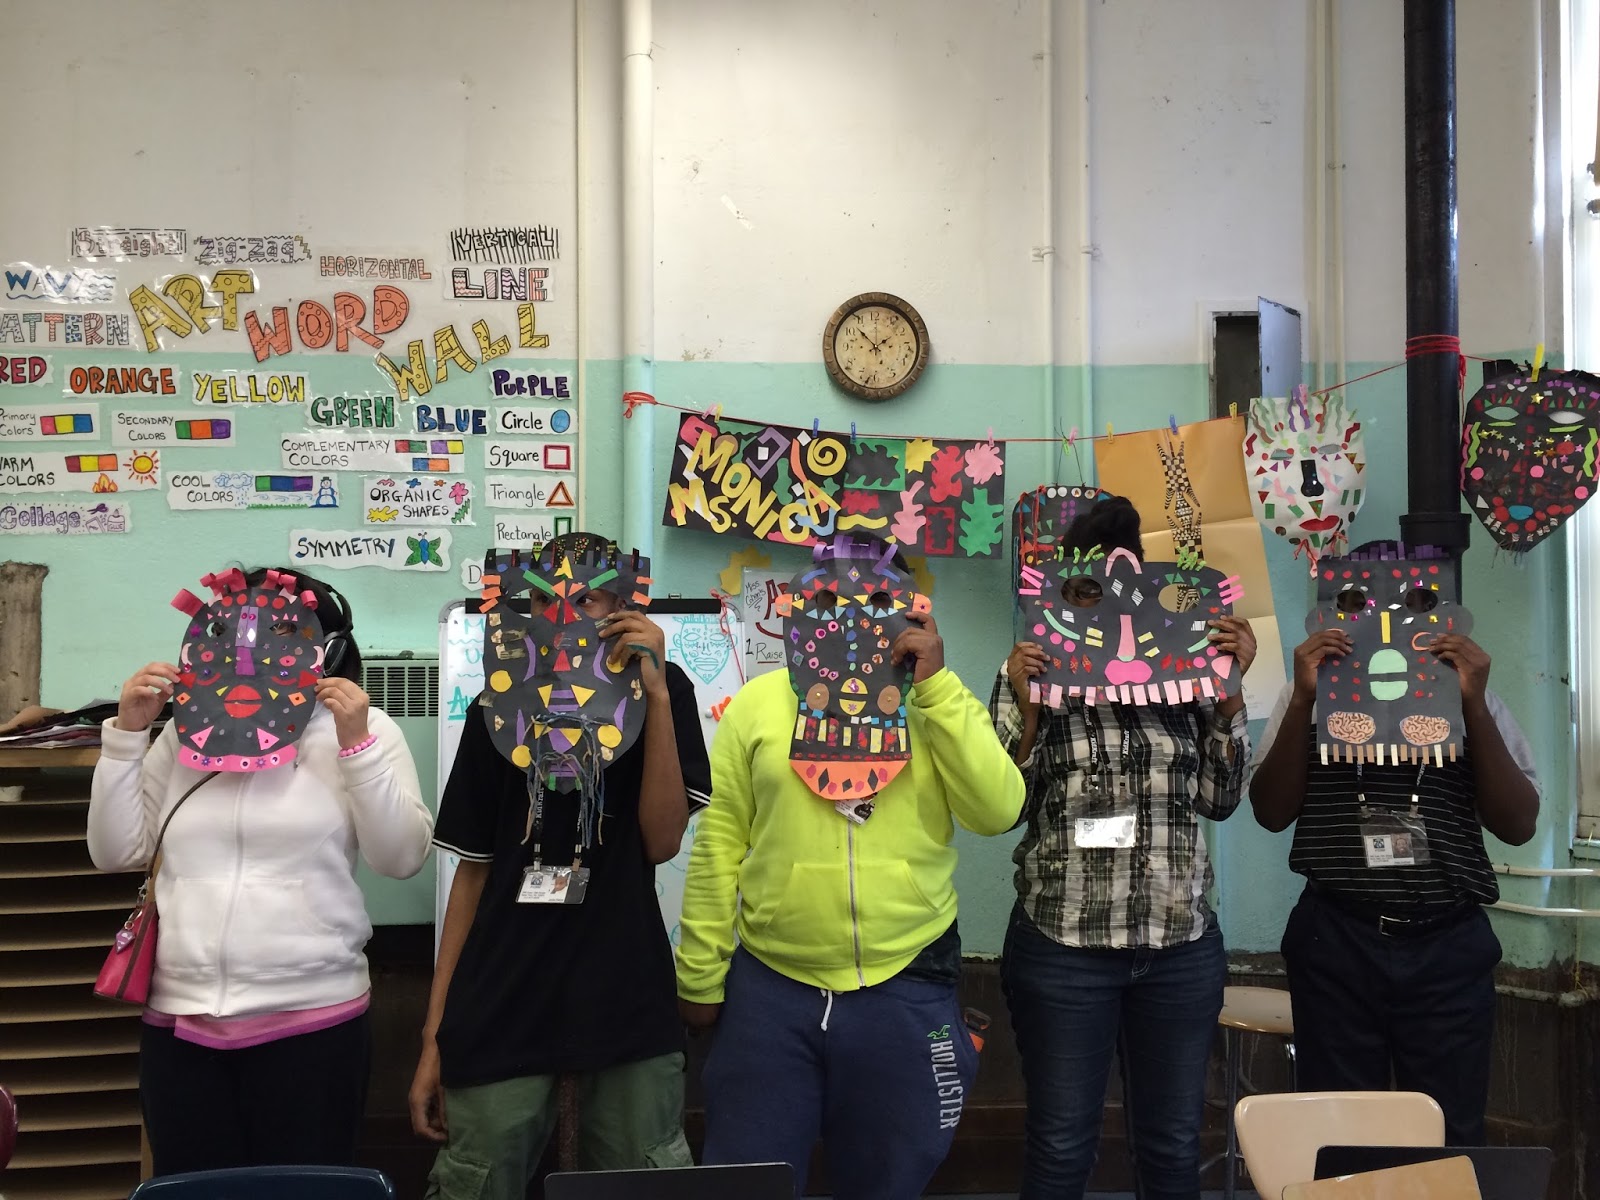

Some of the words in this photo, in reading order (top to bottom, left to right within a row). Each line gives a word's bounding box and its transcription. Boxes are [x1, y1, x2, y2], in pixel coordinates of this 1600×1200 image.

[199, 238, 294, 264] Zig-Zag
[455, 229, 555, 251] VERTICAL
[319, 255, 432, 280] HORIZONTAL
[451, 267, 549, 301] LINE
[128, 269, 255, 353] ART
[244, 285, 410, 363] WORD
[374, 302, 550, 401] WALL
[69, 366, 177, 395] ORANGE
[193, 372, 305, 404] YELLOW
[493, 369, 570, 398] PURPLE
[117, 412, 174, 427] SECONDARY
[310, 396, 395, 428] GREEN
[416, 404, 487, 435] BLUE
[501, 410, 543, 431] Circle
[281, 438, 391, 453] COMPLEMENTARY
[489, 445, 540, 468] Square
[288, 453, 349, 467] COLORS
[171, 475, 211, 489] COOL
[685, 430, 842, 543] MONICA
[186, 490, 234, 503] COLORS
[369, 487, 443, 502] ORGANIC
[490, 482, 546, 508] Triangle
[0, 505, 82, 534] Collage
[402, 504, 450, 518] SHAPES
[496, 522, 552, 542] Rectangle
[294, 536, 396, 559] SYMMETRY
[755, 642, 784, 661] Raise
[930, 1040, 964, 1130] HOLLISTER
